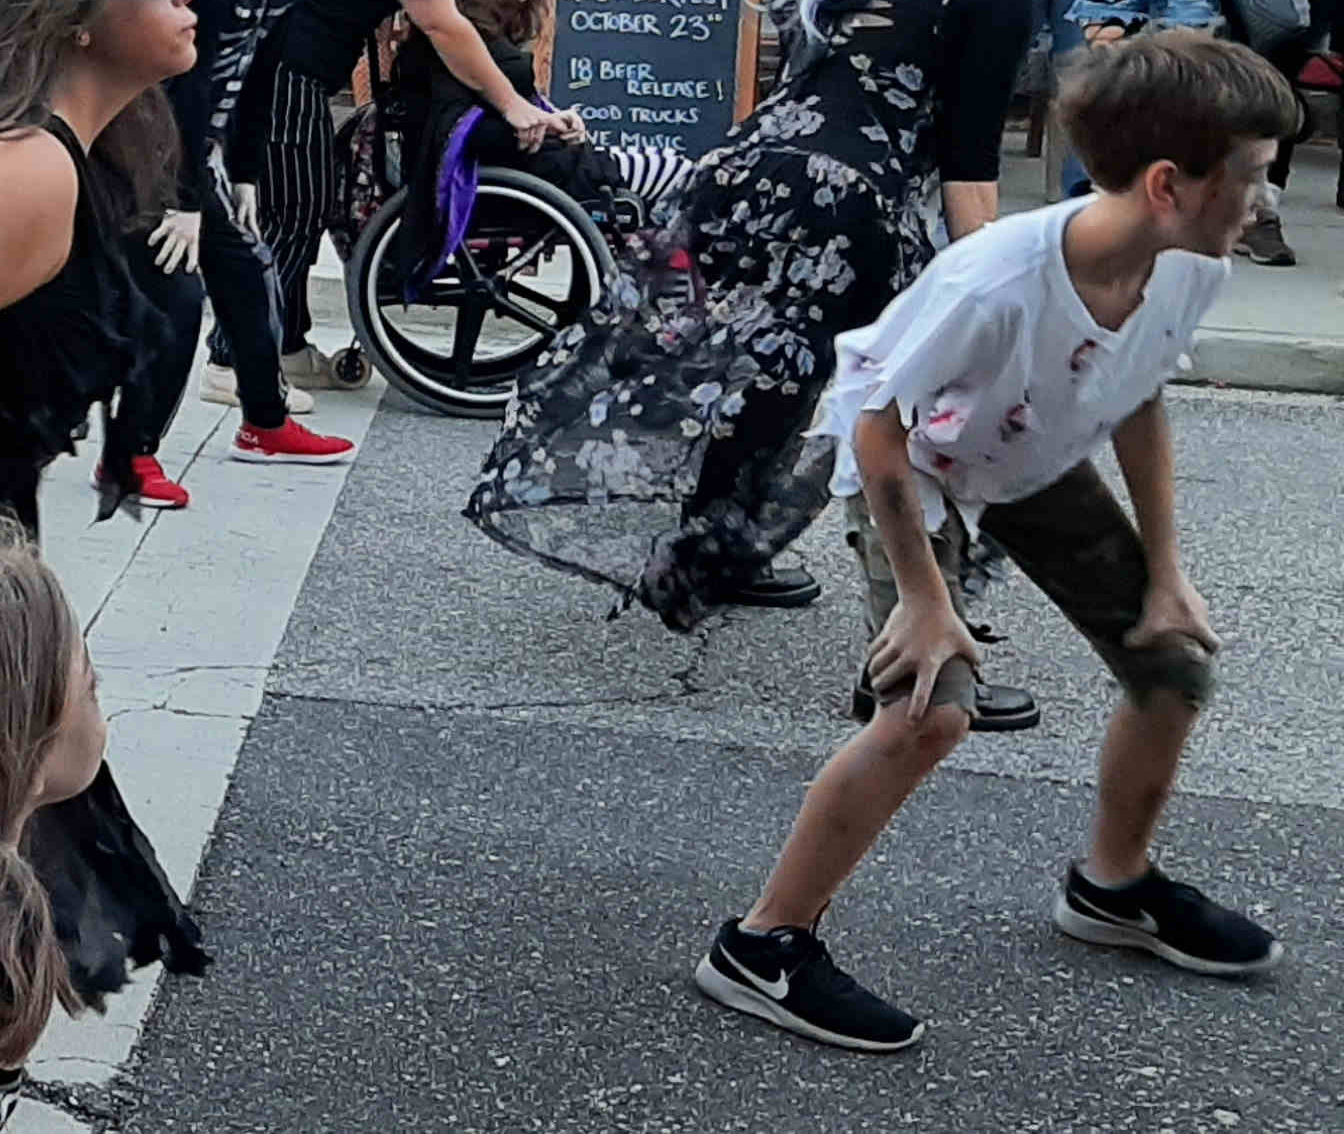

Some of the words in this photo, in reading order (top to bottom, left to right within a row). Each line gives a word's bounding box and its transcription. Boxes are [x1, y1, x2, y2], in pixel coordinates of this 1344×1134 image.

[571, 10, 663, 36] OCTOBER
[570, 57, 593, 82] 18
[599, 60, 655, 81] BEER
[628, 107, 700, 124] TRUCKS
[621, 131, 687, 151] MUSIC
